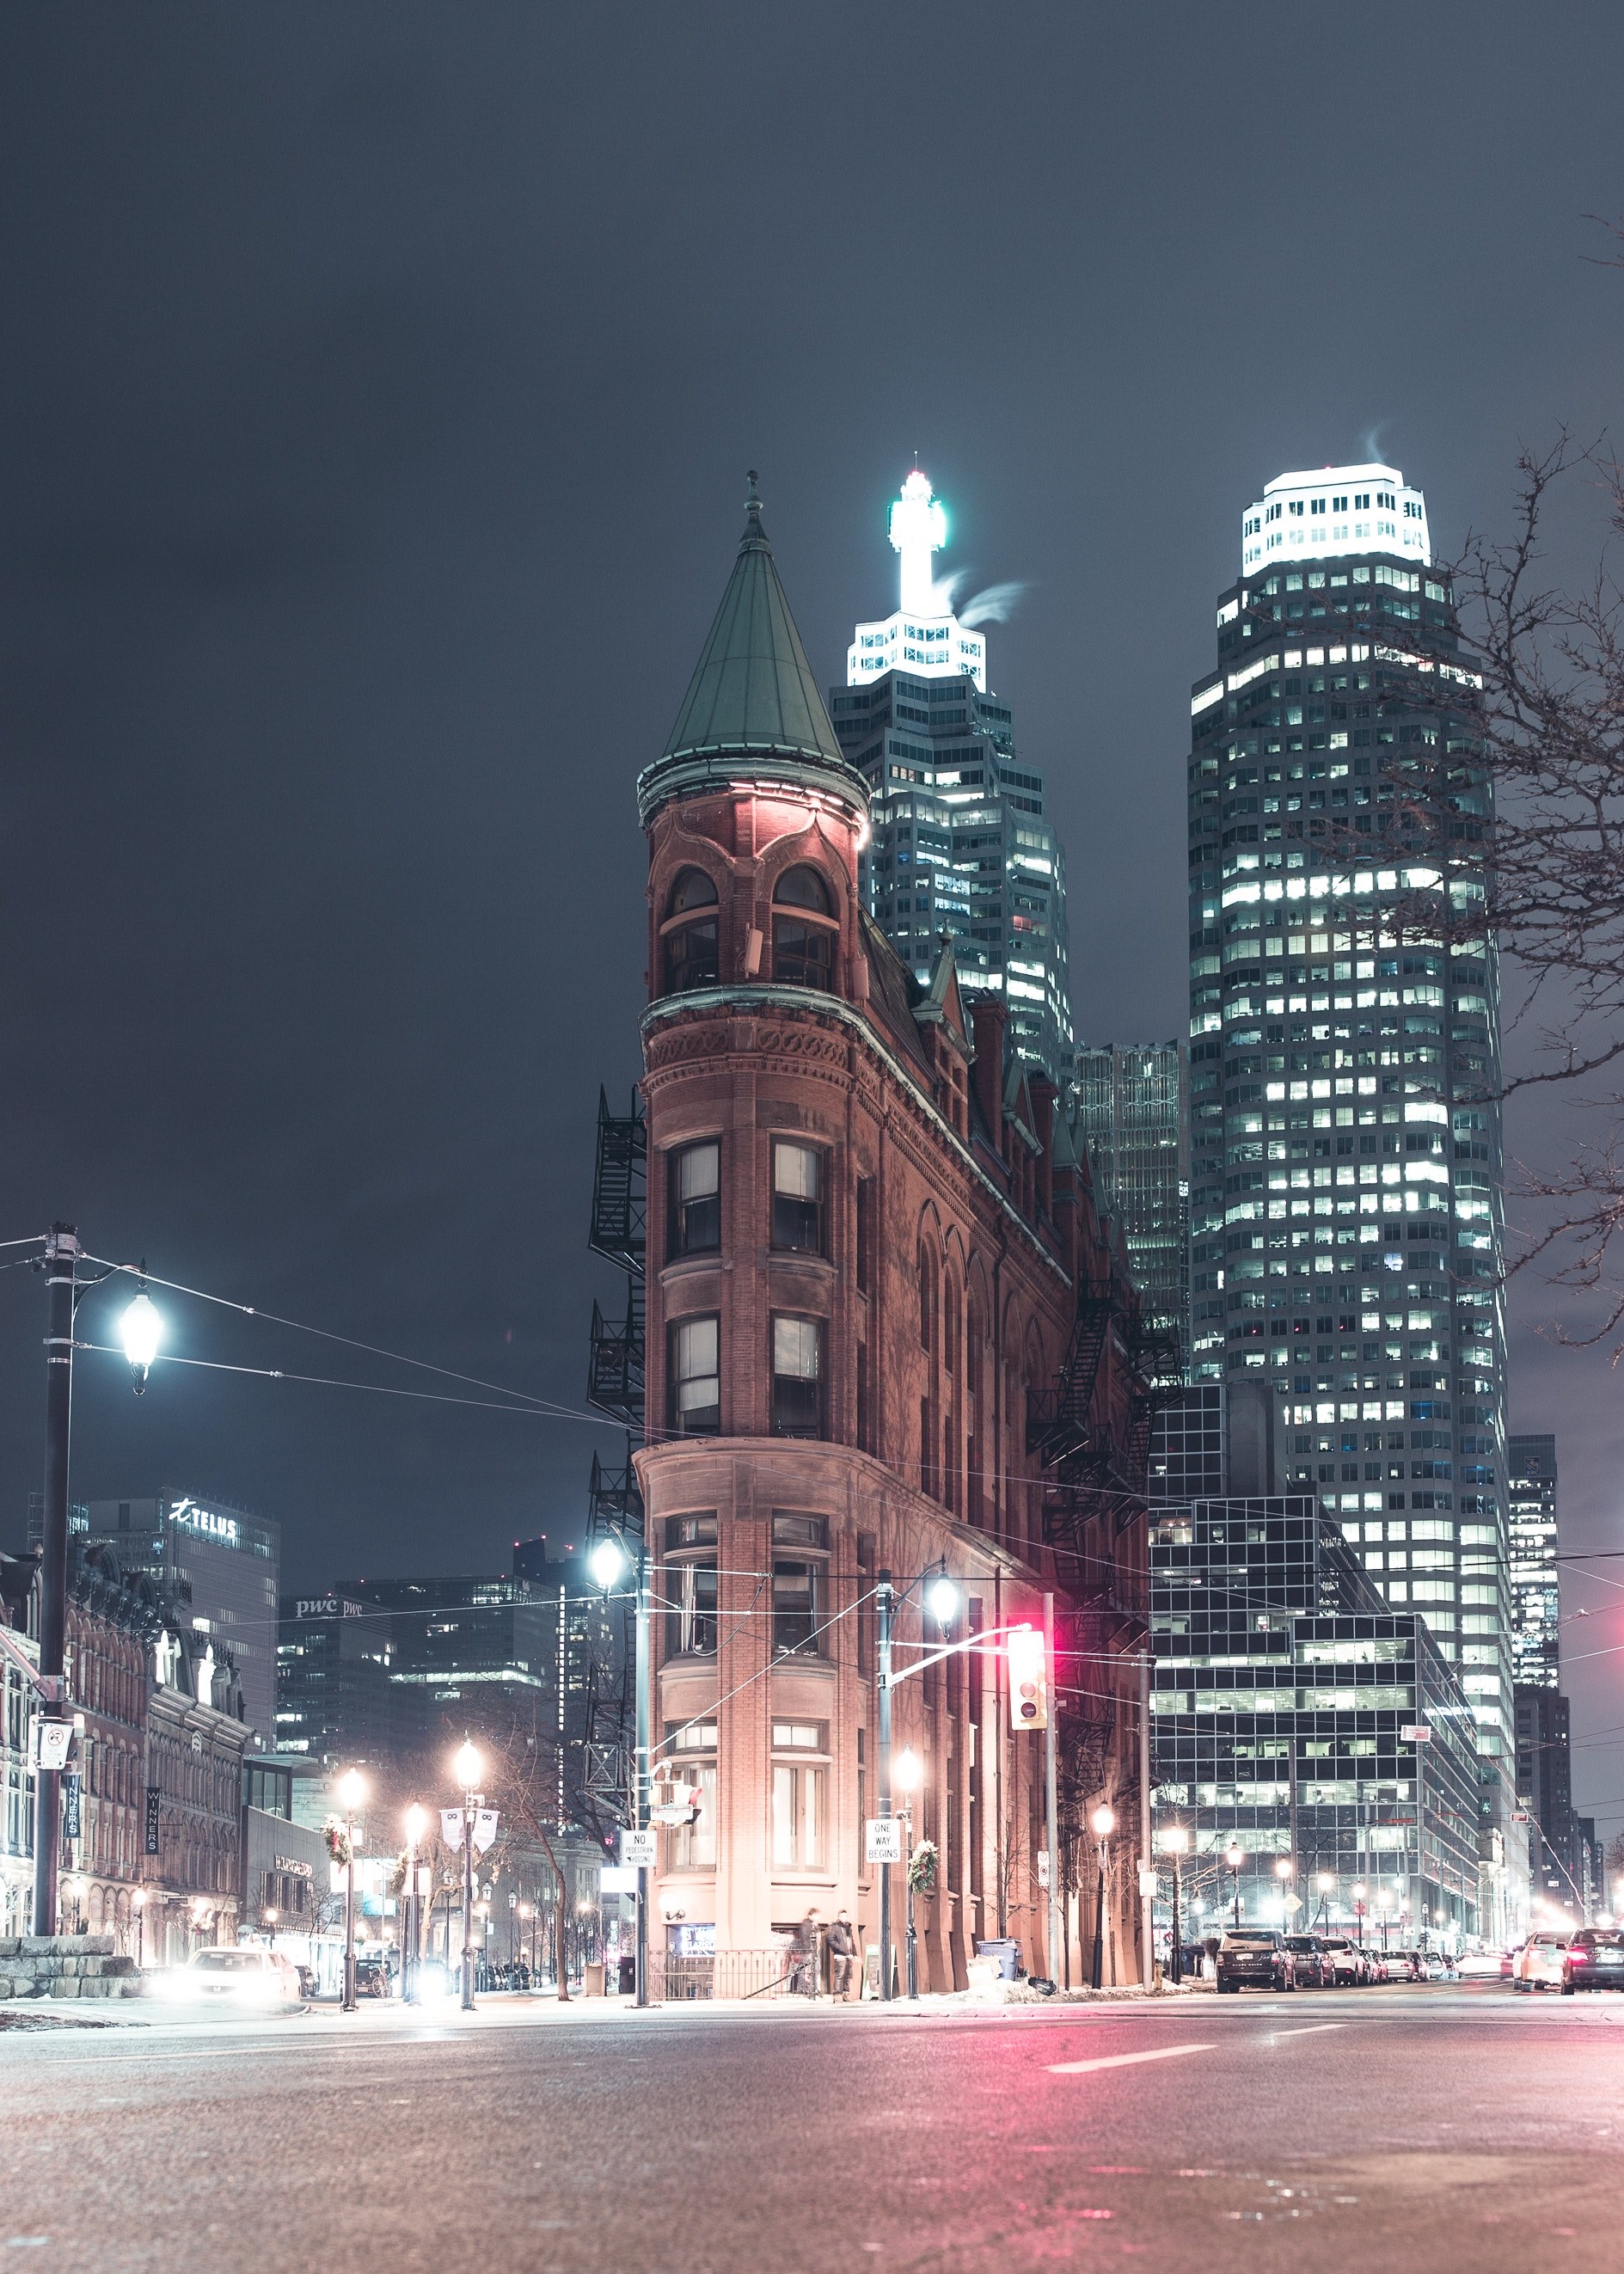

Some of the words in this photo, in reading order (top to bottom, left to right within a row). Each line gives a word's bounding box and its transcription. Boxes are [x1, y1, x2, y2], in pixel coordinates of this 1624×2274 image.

[191, 1507, 236, 1539] TELUS
[296, 1599, 337, 1618] pwc
[343, 1601, 363, 1618] pwc
[69, 1776, 78, 1834] INNERS
[148, 1792, 159, 1850] WINNERS
[874, 1823, 892, 1833] ONE
[634, 1835, 646, 1845] NO
[875, 1836, 892, 1846] WAY
[868, 1849, 898, 1859] BEGINS
